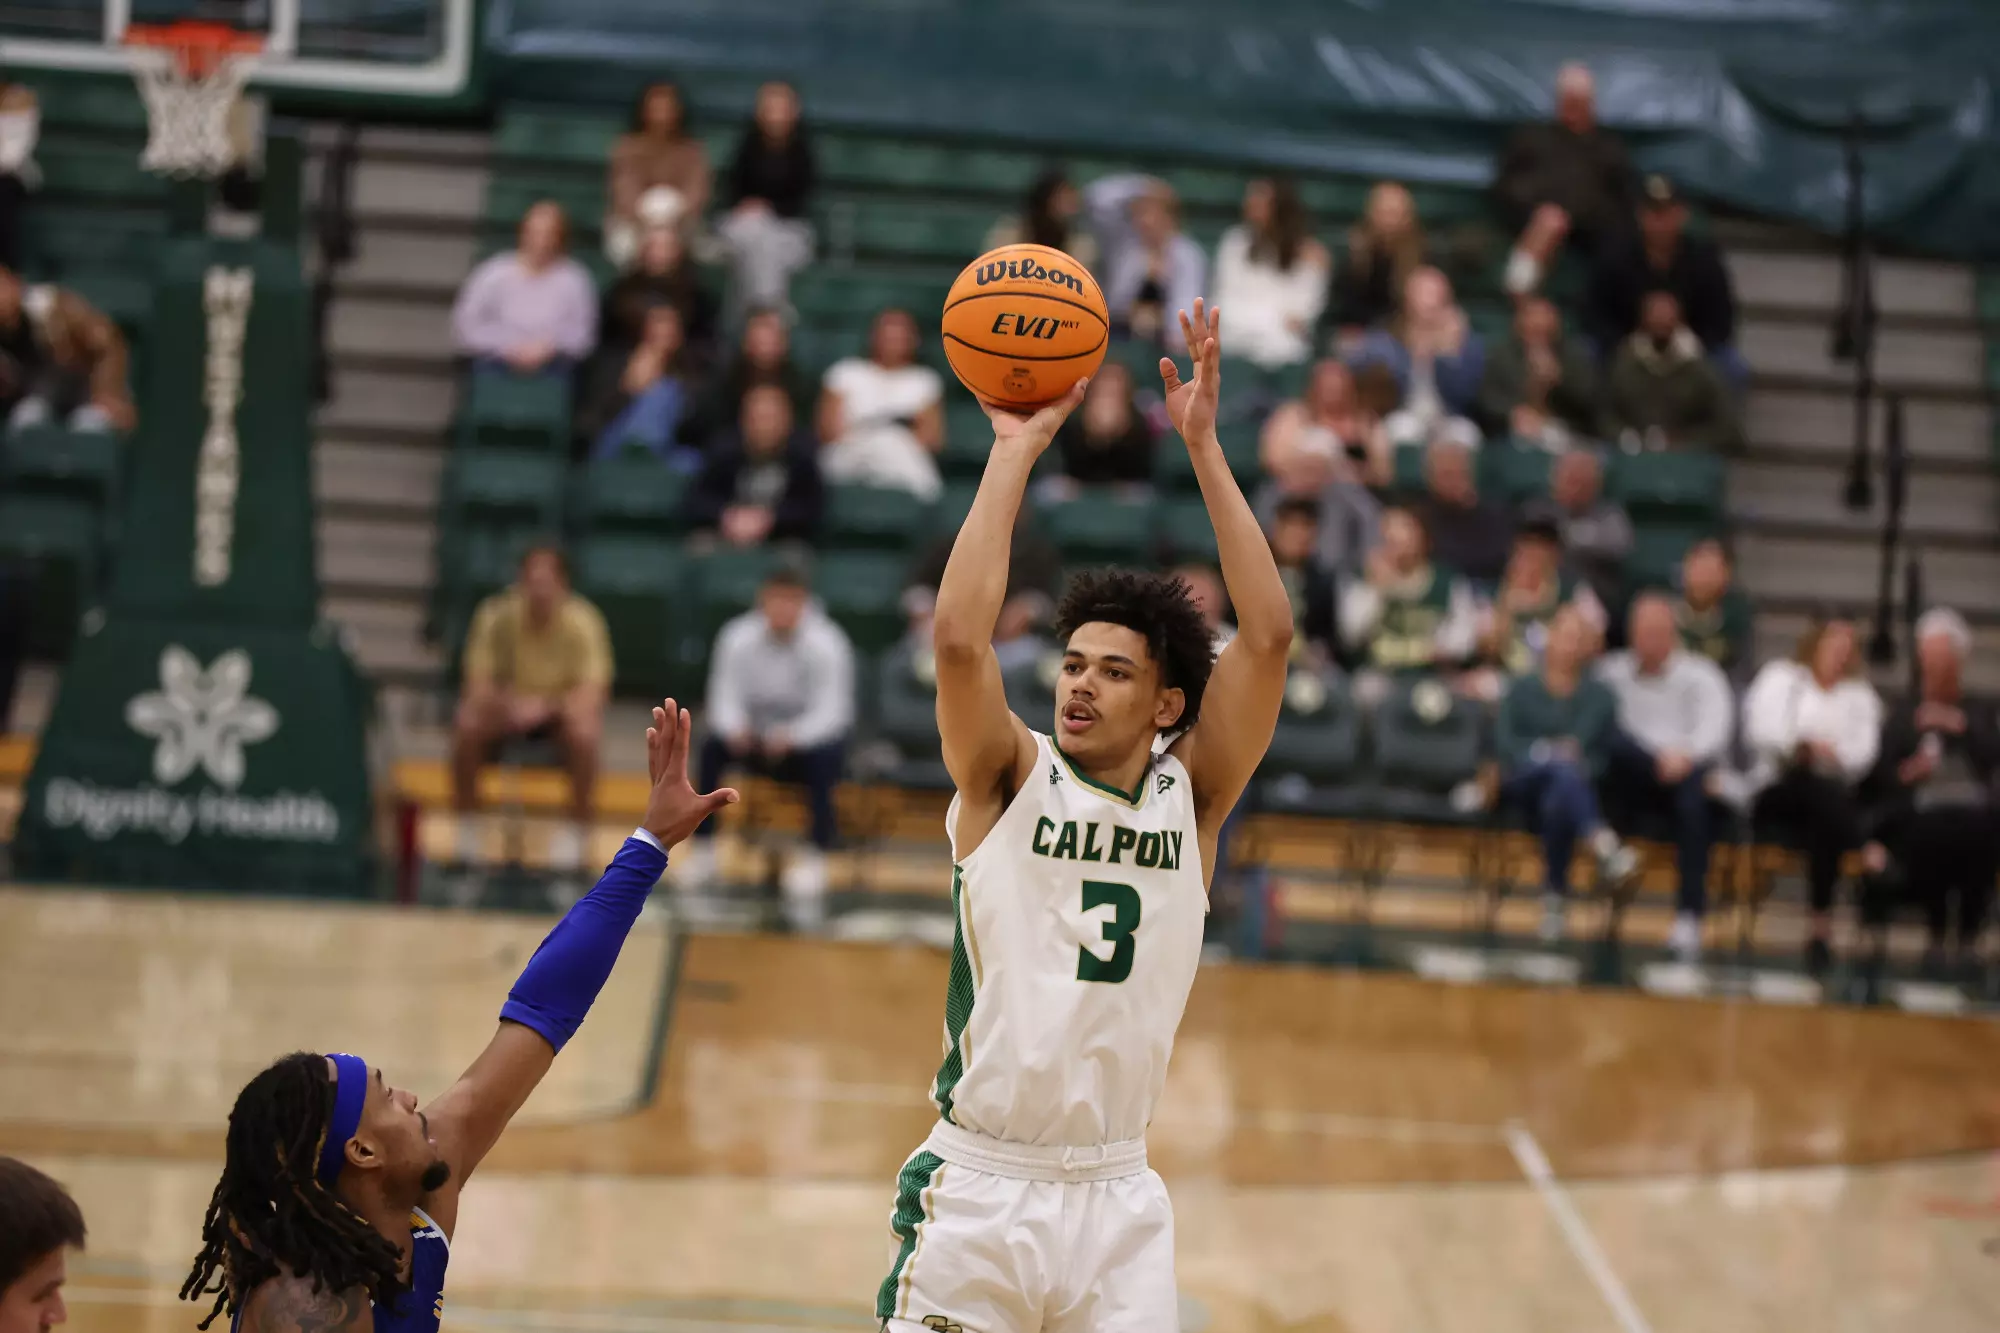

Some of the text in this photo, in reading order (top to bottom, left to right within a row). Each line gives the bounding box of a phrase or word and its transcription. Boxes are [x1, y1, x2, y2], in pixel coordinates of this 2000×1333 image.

[976, 258, 1084, 296] Wilson
[991, 312, 1080, 340] EVO NXT
[46, 777, 338, 844] Dignity Health
[1032, 815, 1183, 871] CAL POLY
[1076, 878, 1142, 984] 3
